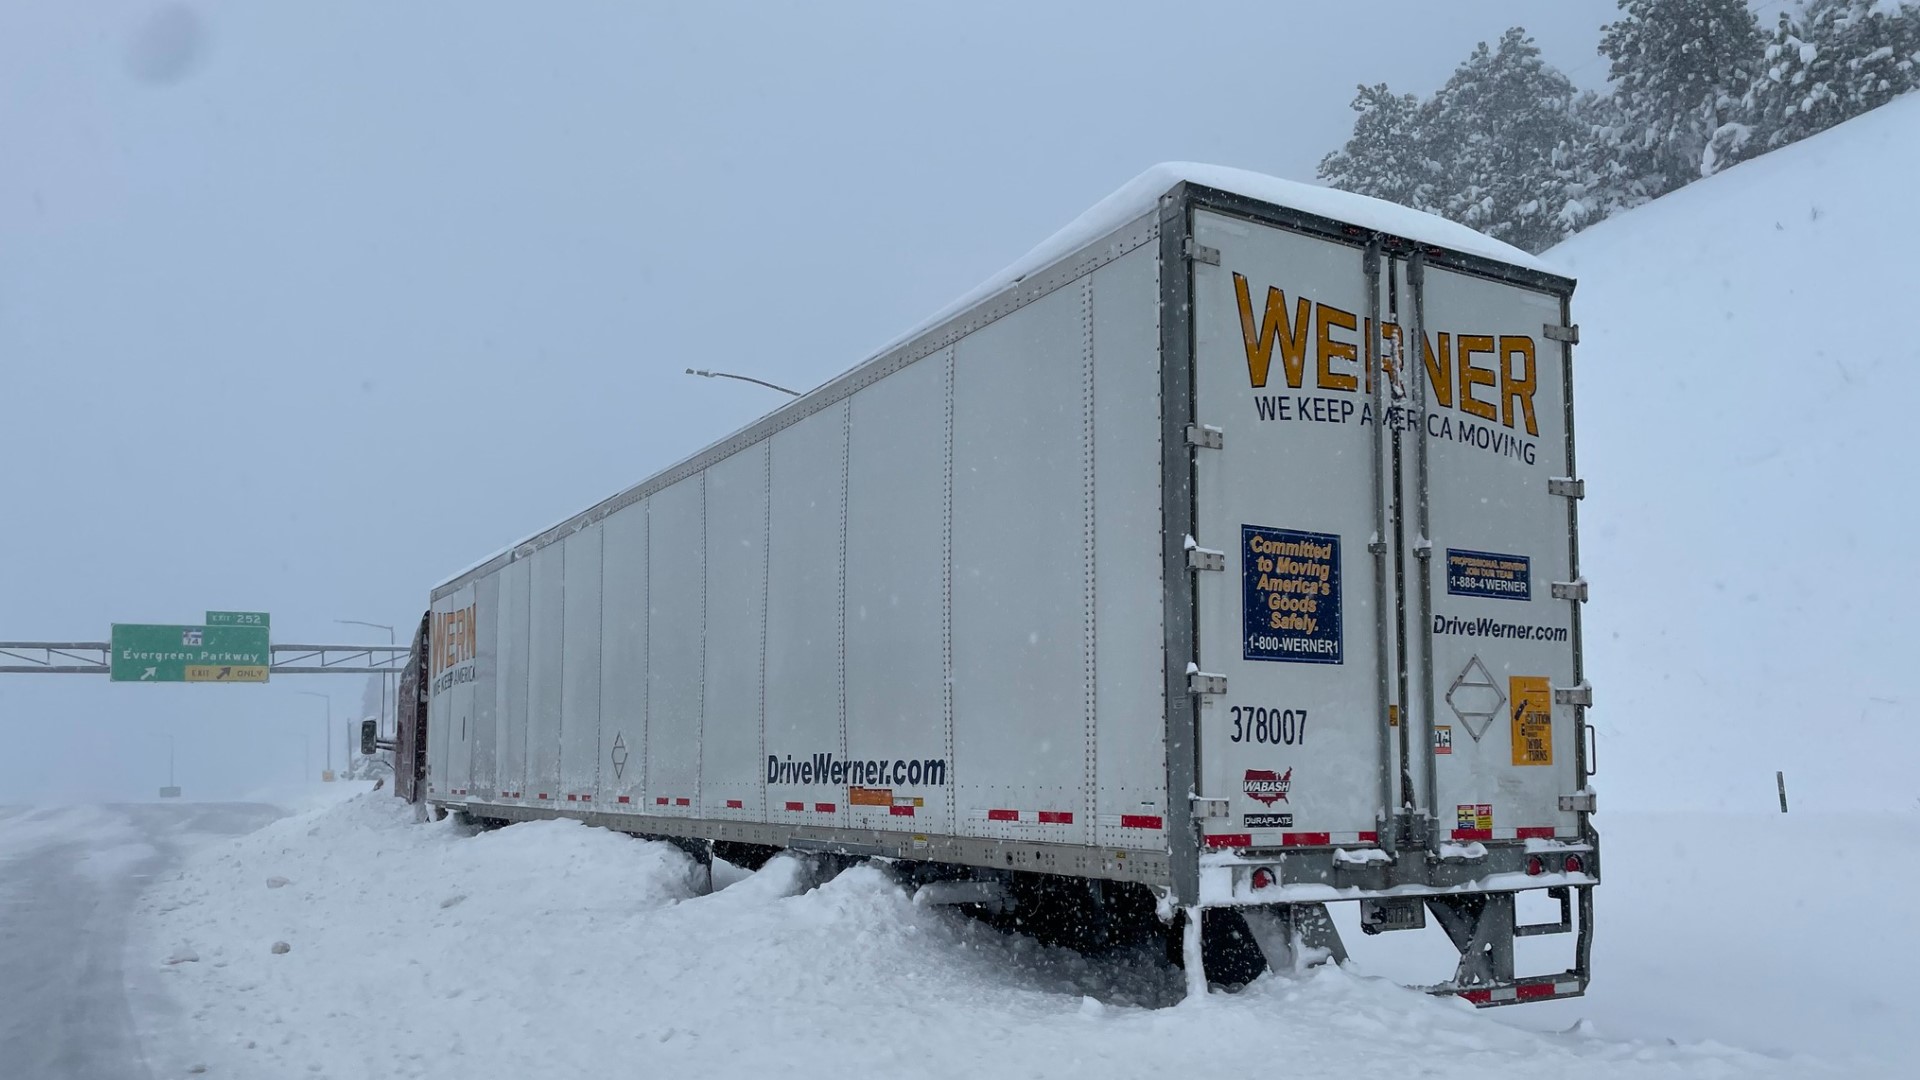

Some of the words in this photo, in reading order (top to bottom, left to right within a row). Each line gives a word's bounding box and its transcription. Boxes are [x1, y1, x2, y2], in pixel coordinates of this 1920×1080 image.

[1255, 396, 1292, 421] WE
[1297, 396, 1354, 424] KEEP
[1458, 420, 1536, 466] MOVING
[1251, 535, 1332, 560] Committed
[1257, 556, 1273, 573] to
[1276, 556, 1330, 581] Moving
[1256, 573, 1330, 596] America's
[1268, 592, 1317, 613] Goods
[237, 615, 261, 624] 252
[1270, 611, 1319, 635] Safely.
[1433, 614, 1568, 643] DriveWerner.com
[431, 602, 476, 679] WERN
[1248, 635, 1339, 654] 1-800-WERNER1
[123, 650, 193, 662] Evergreen
[201, 651, 259, 663] Parkway
[192, 669, 210, 678] EXIT
[237, 670, 264, 678] ONLY
[1230, 705, 1307, 745] 378007
[767, 752, 946, 786] DriveWerner.com
[1244, 781, 1290, 792] WABASH
[1244, 816, 1293, 825] DURAPLATE
